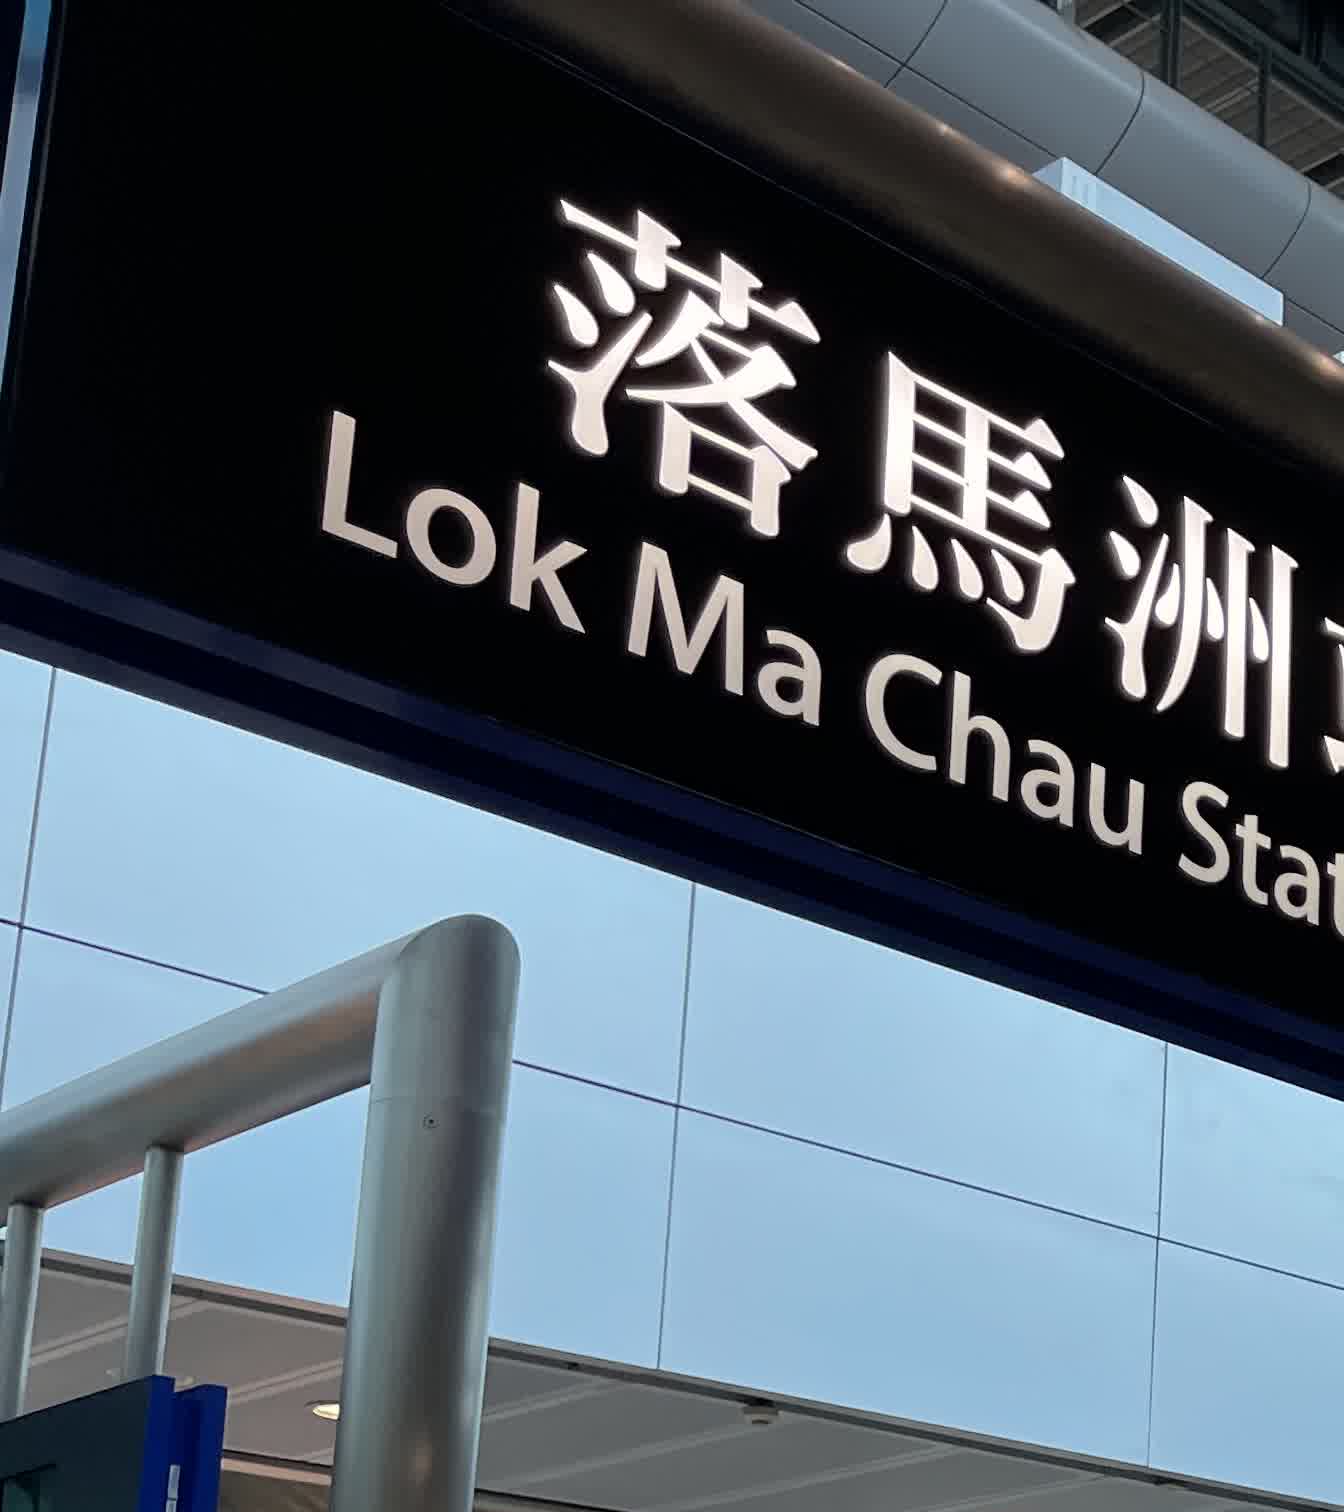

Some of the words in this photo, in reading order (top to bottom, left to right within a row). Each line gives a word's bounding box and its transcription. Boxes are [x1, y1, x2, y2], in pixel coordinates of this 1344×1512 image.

[321, 409, 588, 634] Lok
[627, 540, 823, 727] Ma
[865, 652, 1146, 856] Chau
